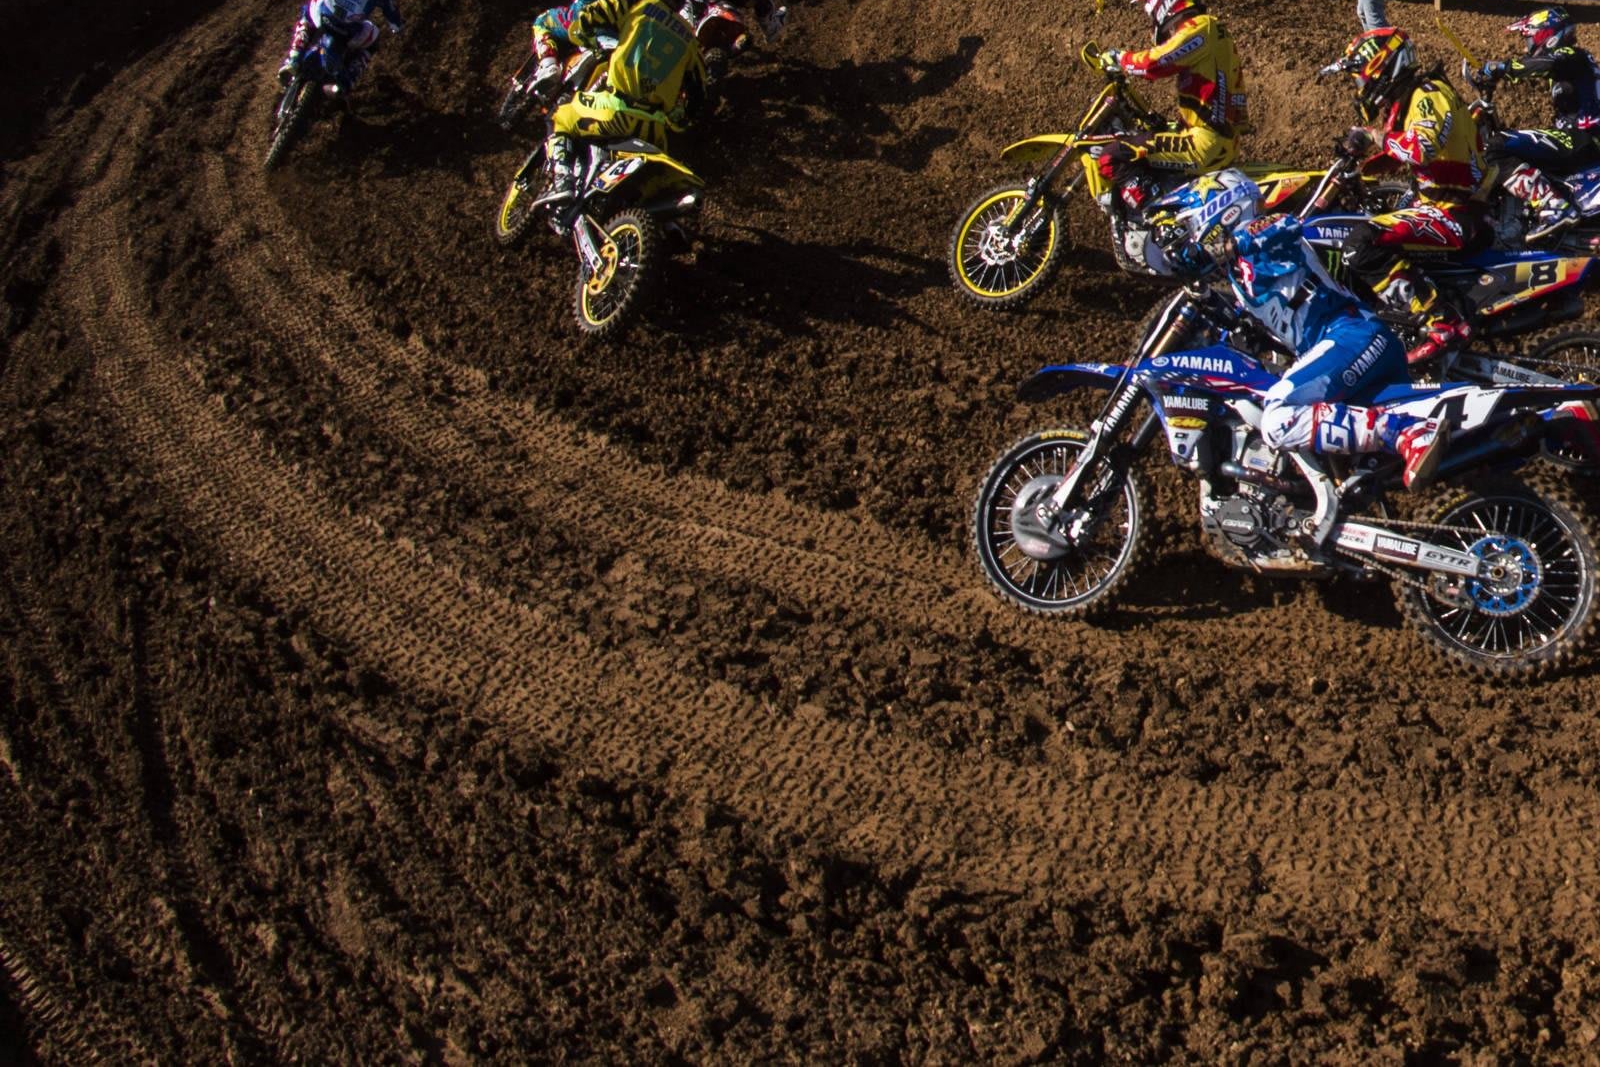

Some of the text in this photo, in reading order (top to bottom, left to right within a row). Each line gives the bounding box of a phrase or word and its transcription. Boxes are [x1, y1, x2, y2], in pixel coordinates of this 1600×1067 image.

[1199, 181, 1250, 222] 100%
[1317, 226, 1353, 239] YAMA
[1530, 261, 1558, 289] 8
[1171, 356, 1234, 374] YAMAHA
[1352, 334, 1389, 376] YAMAHA
[1104, 384, 1138, 433] YAMAHA
[1163, 395, 1209, 411] YAMALUBE
[1426, 393, 1470, 432] 4
[1377, 537, 1419, 555] YAMALUBE
[1424, 551, 1472, 568] GYTR
